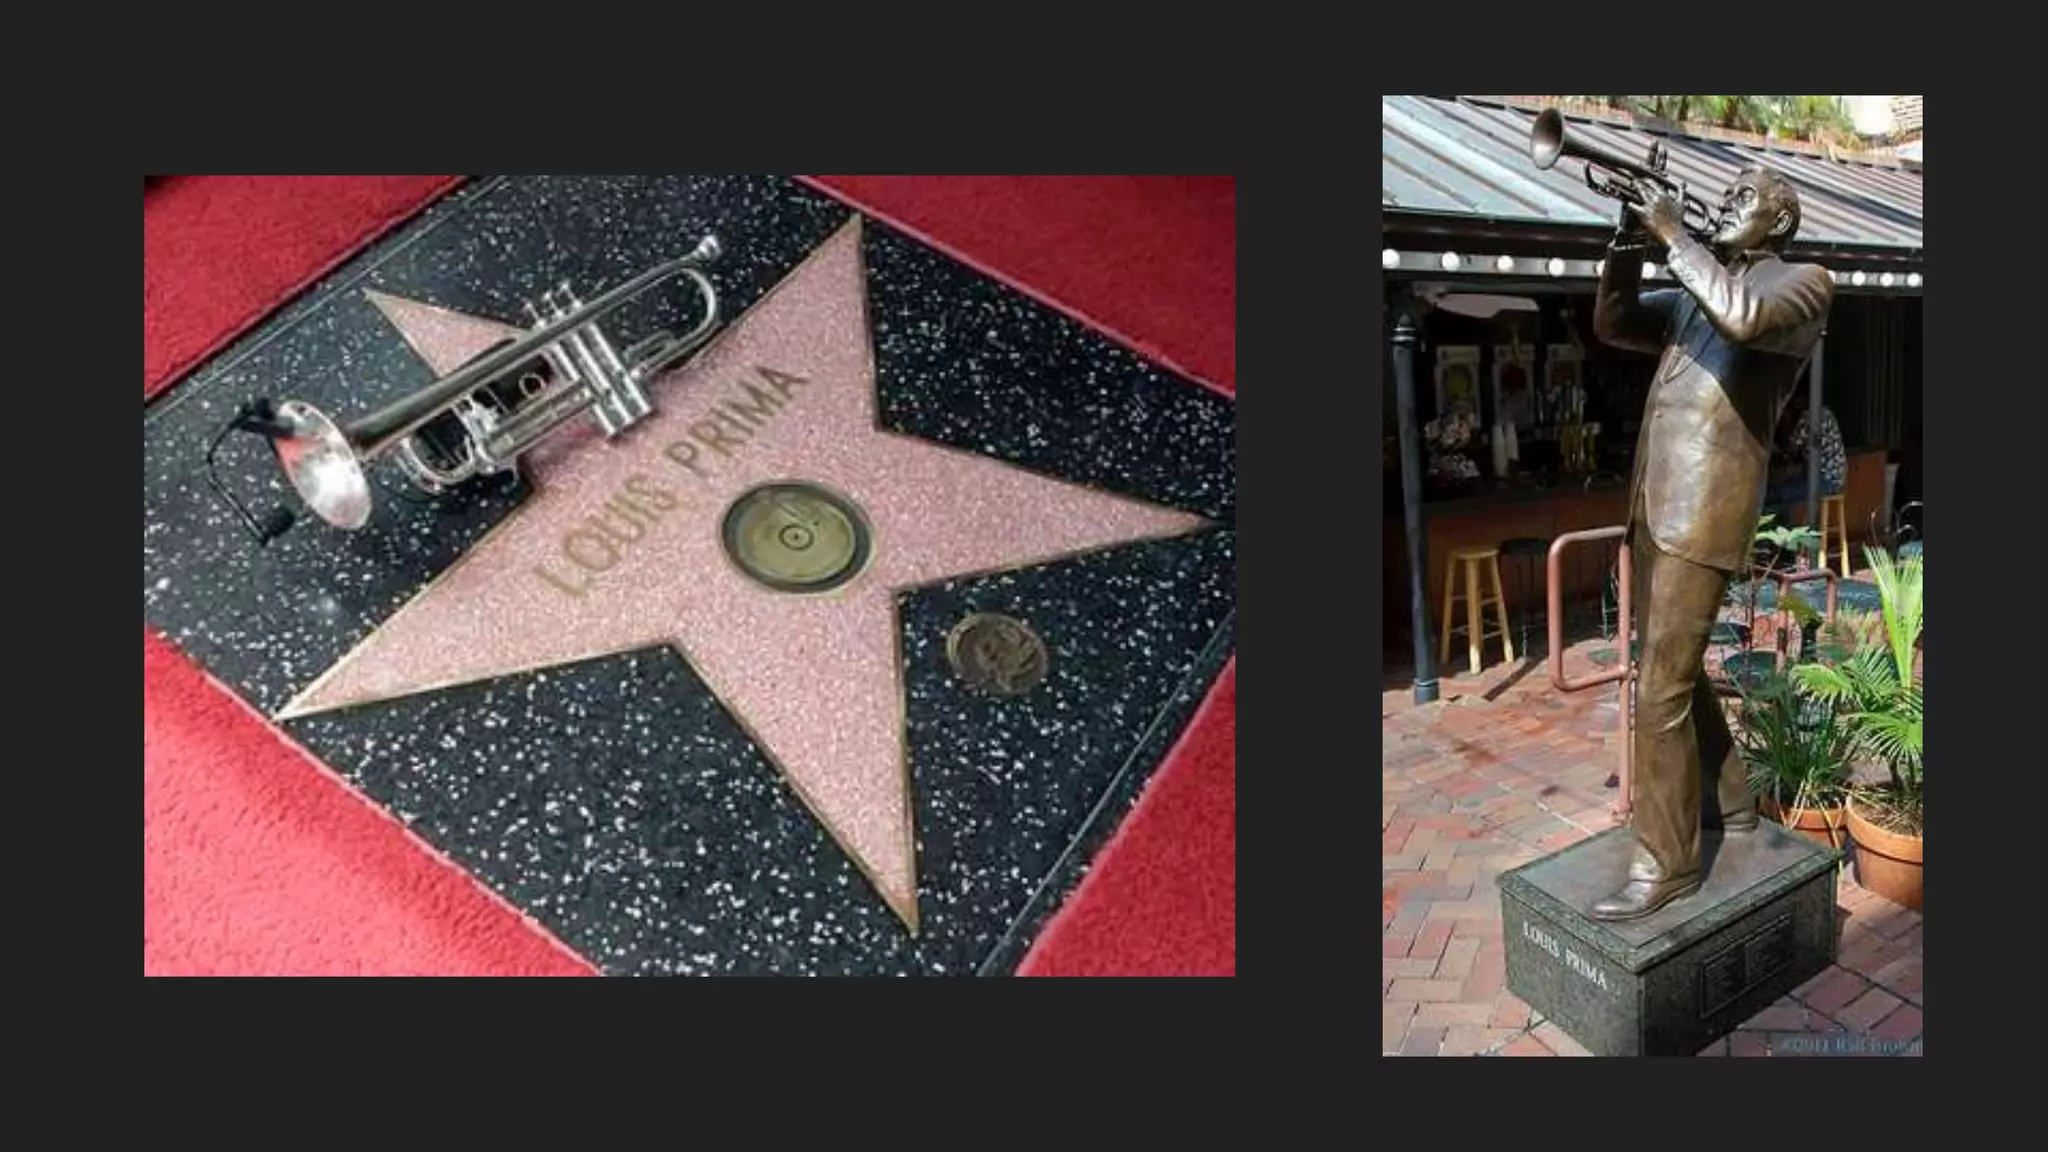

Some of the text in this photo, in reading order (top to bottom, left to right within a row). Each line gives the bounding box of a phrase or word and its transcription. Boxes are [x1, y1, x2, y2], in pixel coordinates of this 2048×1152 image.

[534, 366, 810, 598] LOUIS PRIMA
[1523, 921, 1608, 990] LOUIS PRIMA
